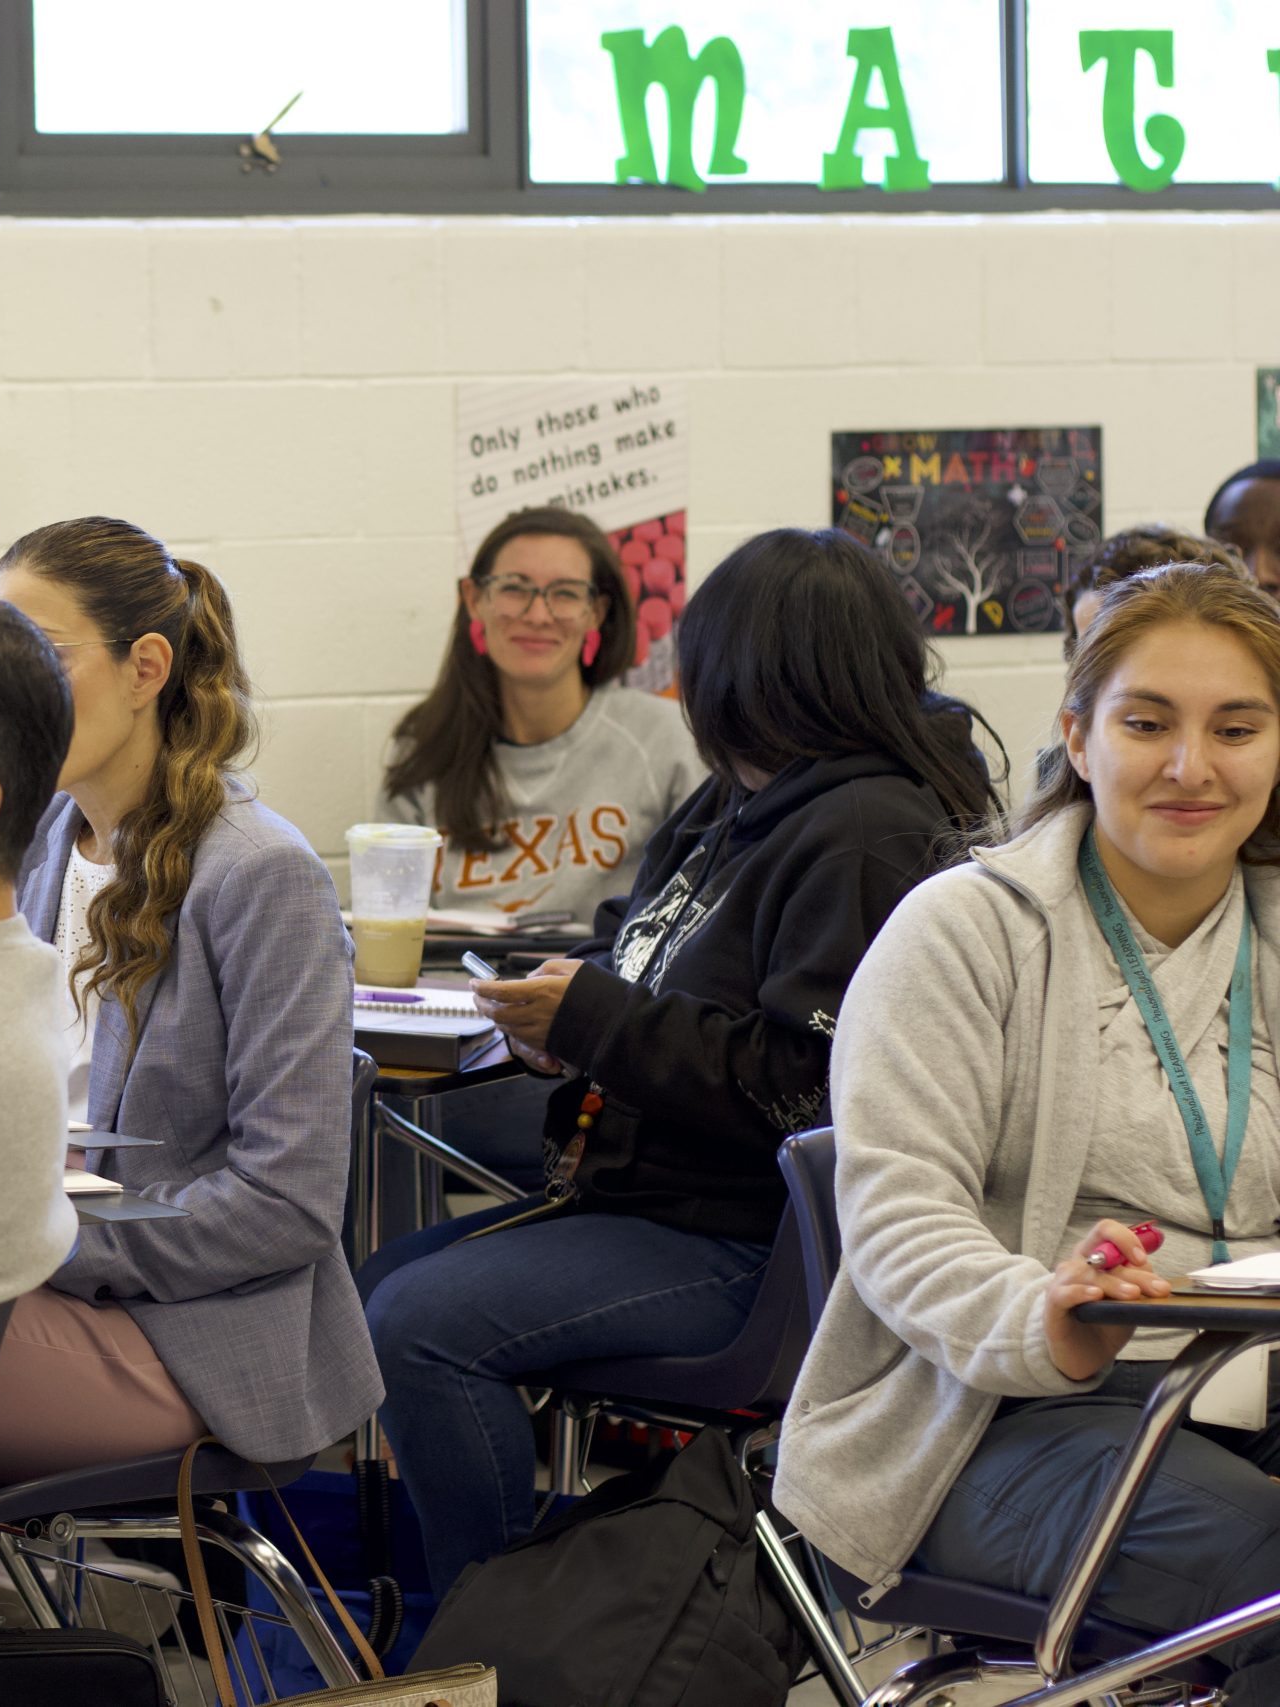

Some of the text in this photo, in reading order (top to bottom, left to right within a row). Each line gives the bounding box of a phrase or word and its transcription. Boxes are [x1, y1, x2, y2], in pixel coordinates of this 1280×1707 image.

[470, 385, 661, 458] Only those who
[471, 420, 677, 497] do nothing make
[910, 451, 1016, 486] MATH
[1112, 922, 1140, 969] LEARNING
[1160, 1030, 1185, 1078] LEARNING
